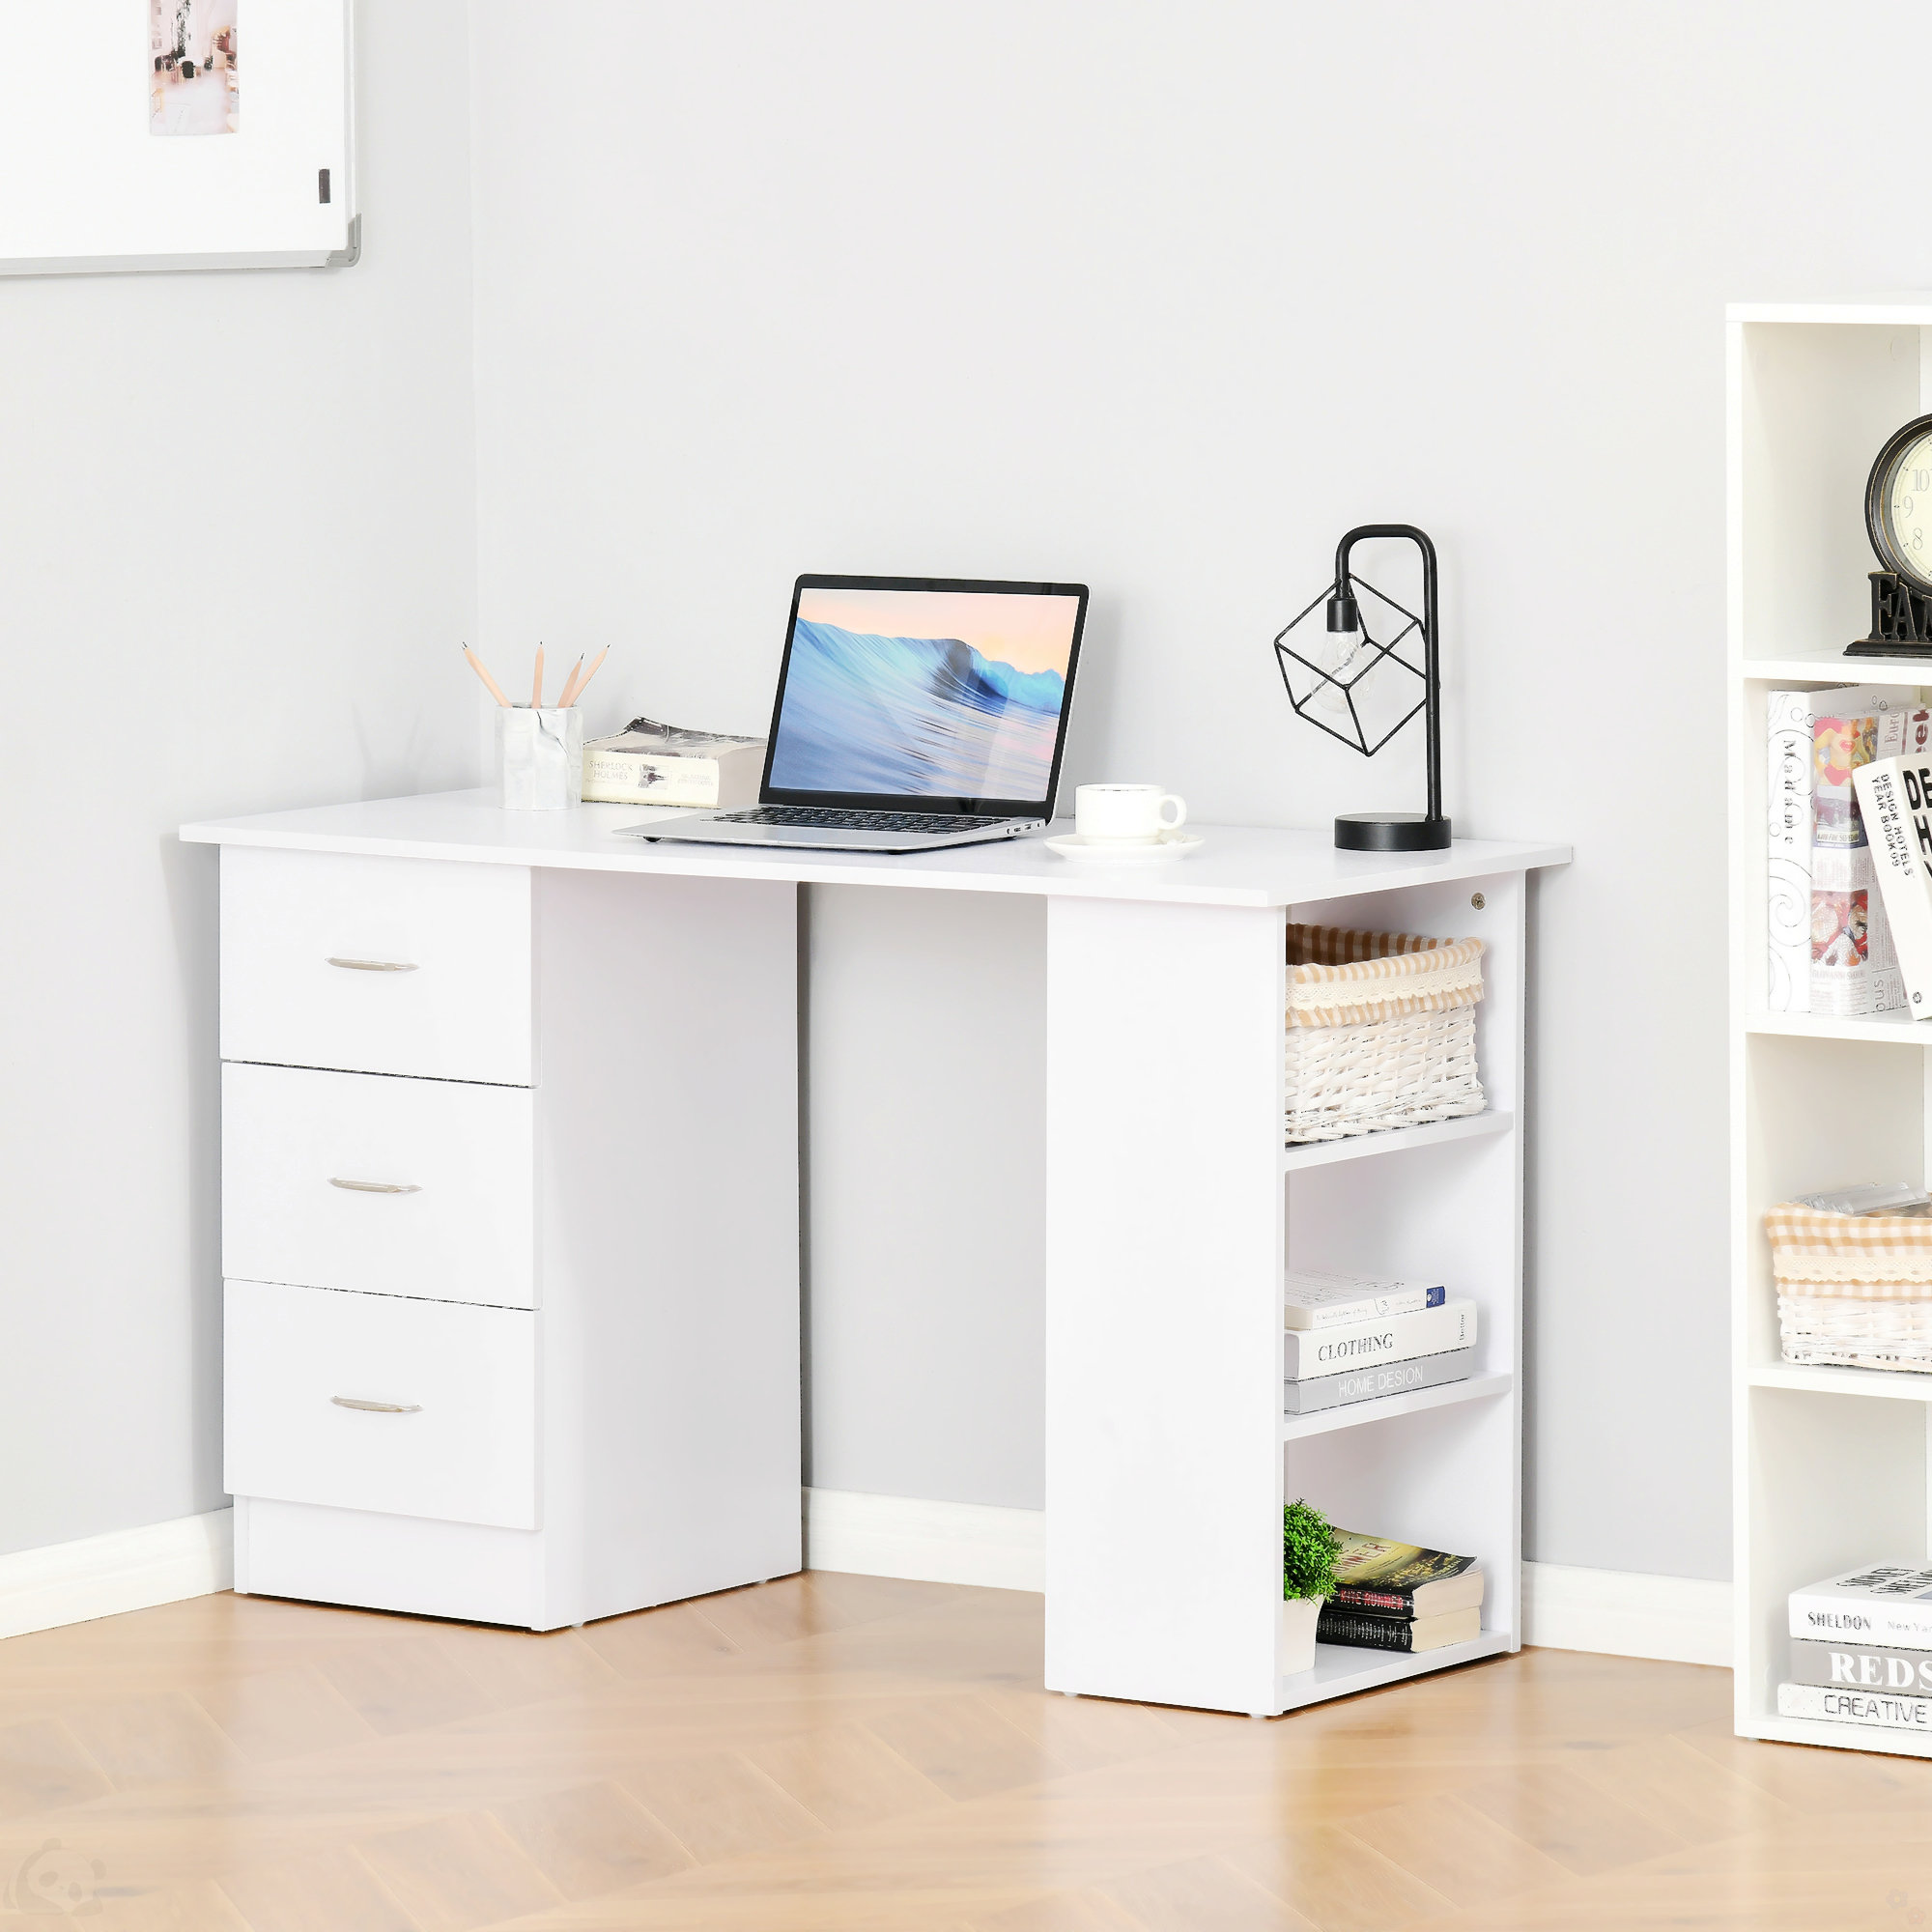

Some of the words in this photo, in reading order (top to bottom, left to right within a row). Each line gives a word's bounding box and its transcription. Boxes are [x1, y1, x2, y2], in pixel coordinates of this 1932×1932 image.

[1911, 469, 1930, 492] 10
[1903, 495, 1914, 519] 9
[1912, 526, 1923, 551] 8
[1867, 571, 1932, 641] FA
[587, 759, 634, 772] SHERLOCK
[593, 770, 629, 781] HOLMES
[1783, 739, 1798, 845] Madame
[1871, 777, 1888, 810] YEAR
[1880, 773, 1901, 821] DESIGN
[1318, 1332, 1394, 1362] CLOTHING
[1338, 1374, 1374, 1399] HOME
[1807, 1610, 1872, 1632] SHELDON
[1887, 1620, 1911, 1633] New
[1824, 1693, 1928, 1724] CREATIVE
